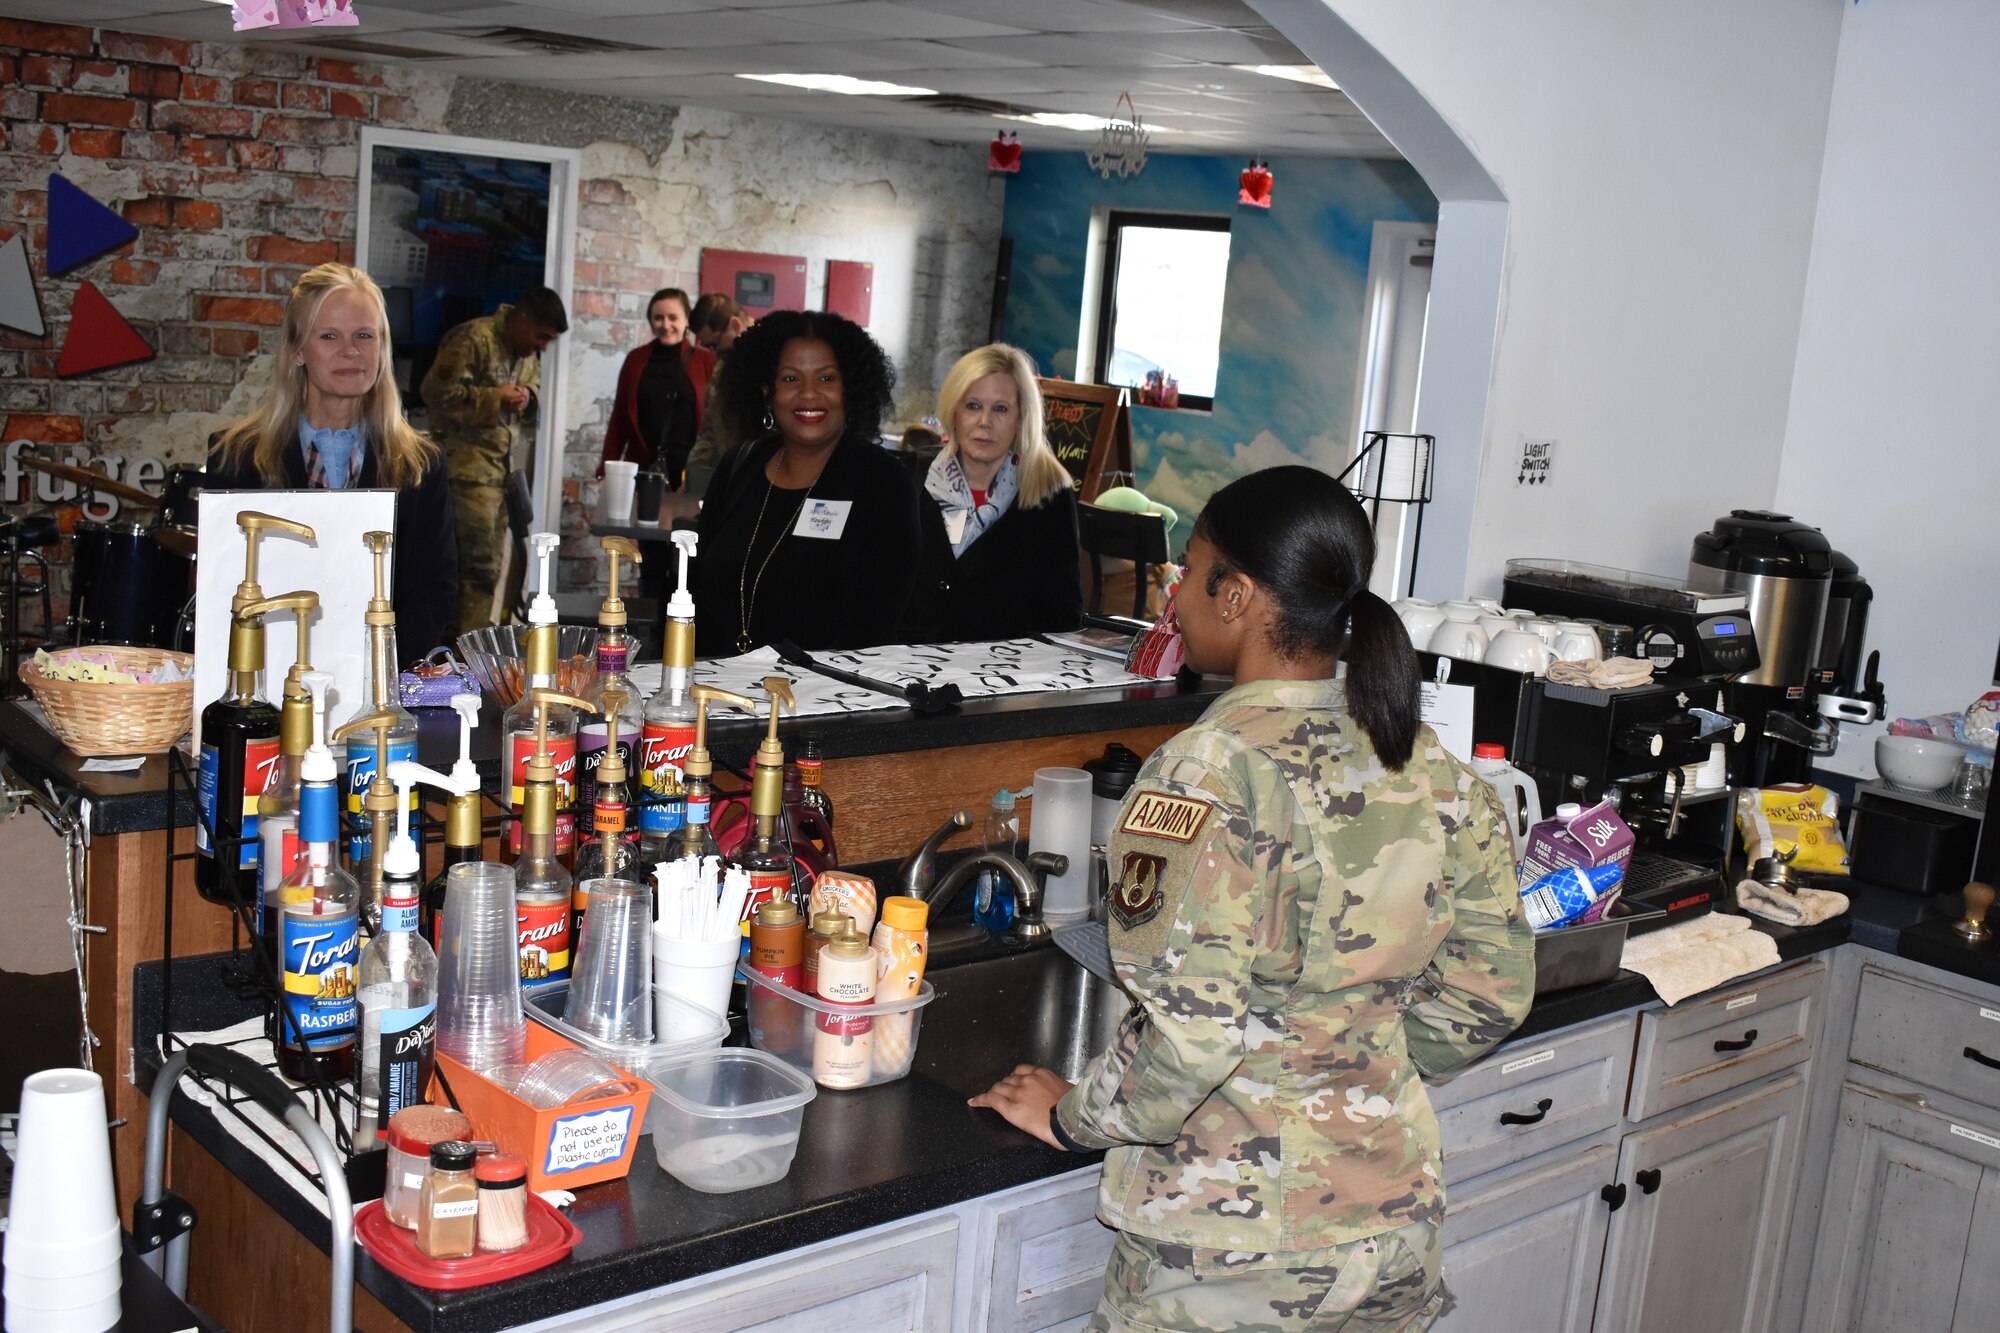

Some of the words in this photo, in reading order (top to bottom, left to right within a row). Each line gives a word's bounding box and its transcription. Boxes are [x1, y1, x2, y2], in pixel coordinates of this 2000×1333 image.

[1057, 442, 1089, 460] Want
[1524, 443, 1551, 458] LIGHT
[1521, 457, 1551, 471] SWITCH
[3, 439, 165, 523] fuge
[643, 736, 695, 770] Toran
[1130, 797, 1202, 836] ADMIN
[1587, 818, 1618, 848] Silk
[1535, 839, 1553, 854] FREE
[1606, 844, 1632, 865] BELIEVE
[292, 931, 358, 977] Toran
[755, 946, 785, 954] PUMPKIN
[829, 987, 870, 995] CHOCOLATE
[562, 1125, 598, 1139] Please
[603, 1120, 618, 1133] do
[1955, 1127, 1976, 1139] FILTERS
[560, 1140, 577, 1153] not
[583, 1136, 603, 1149] use
[605, 1132, 626, 1144] clear
[593, 1143, 617, 1158] cups!
[435, 1205, 476, 1214] CAYENNE
